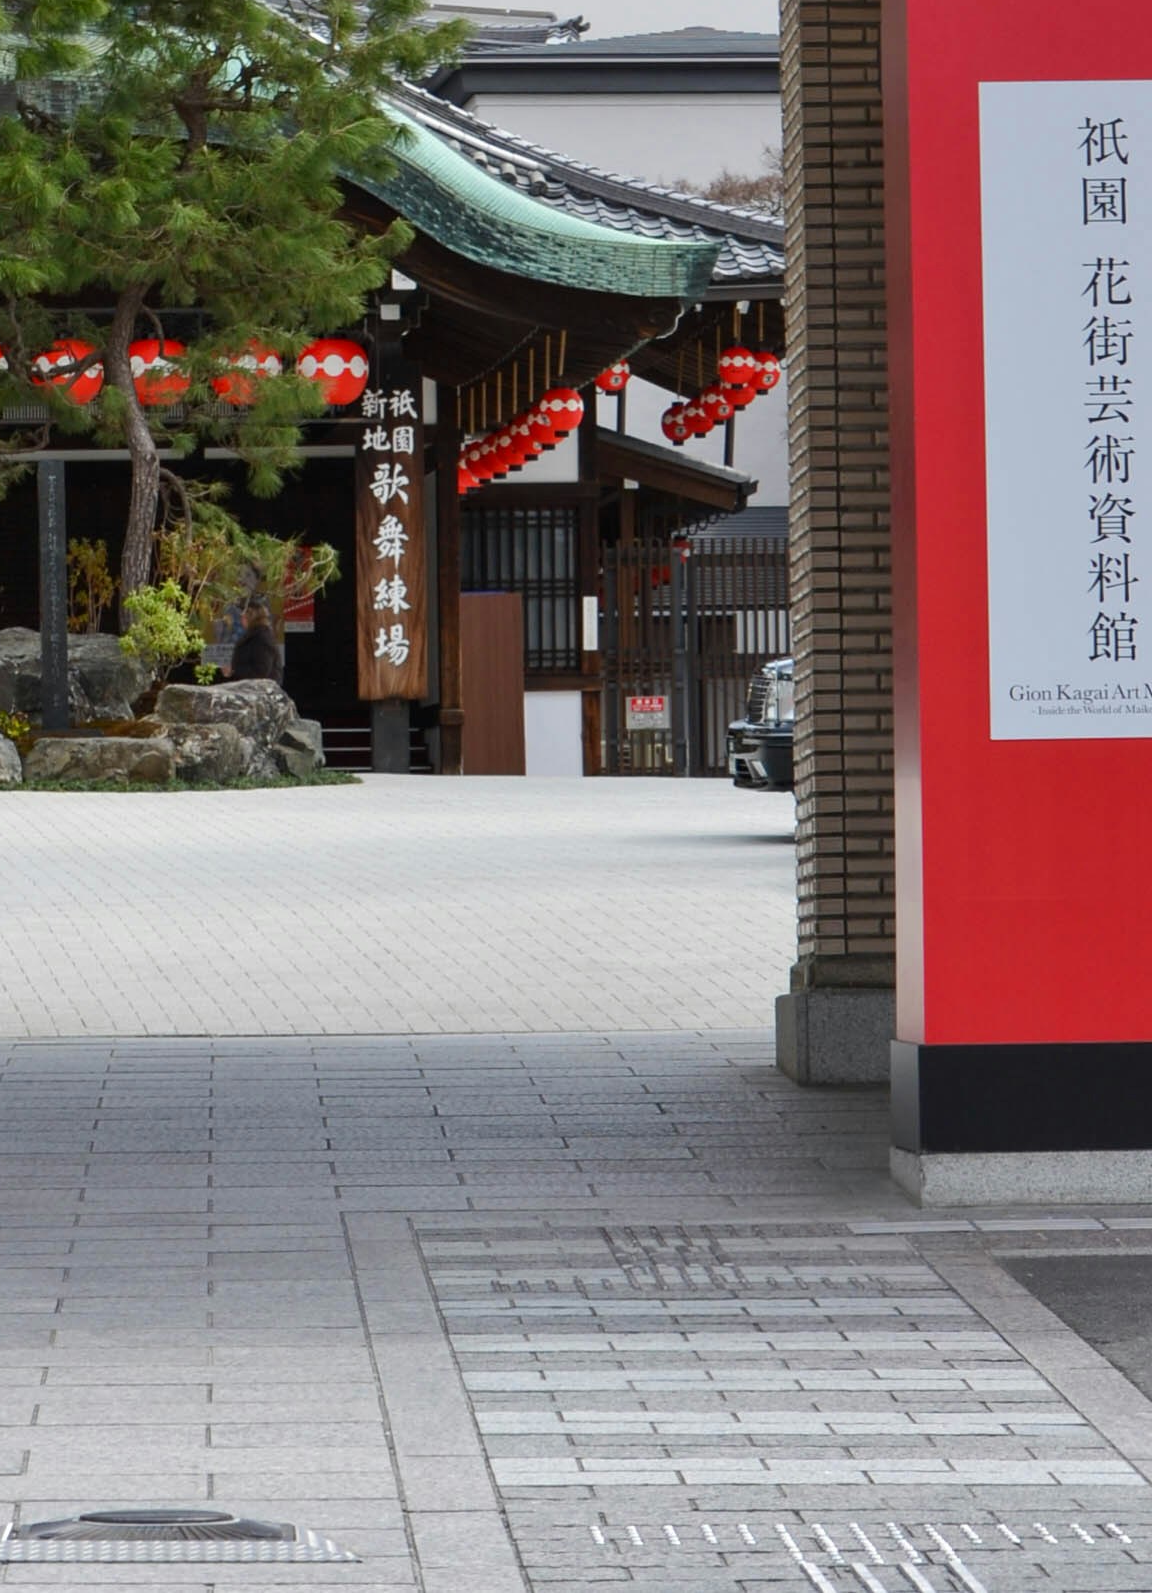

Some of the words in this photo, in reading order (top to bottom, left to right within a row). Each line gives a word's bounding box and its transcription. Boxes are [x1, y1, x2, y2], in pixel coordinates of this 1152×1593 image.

[1078, 117, 1128, 225] 祇園
[361, 389, 391, 451] 新地
[389, 389, 418, 455] 祇園
[1082, 257, 1139, 662] 花街芸術資料館
[369, 463, 410, 667] 歌舞練場
[1009, 684, 1052, 702] Gion
[1056, 683, 1109, 705] Kagai
[1111, 683, 1140, 700] Art
[1038, 707, 1066, 716] Inside
[1067, 706, 1083, 715] the
[1084, 705, 1113, 715] World
[1113, 705, 1124, 715] of
